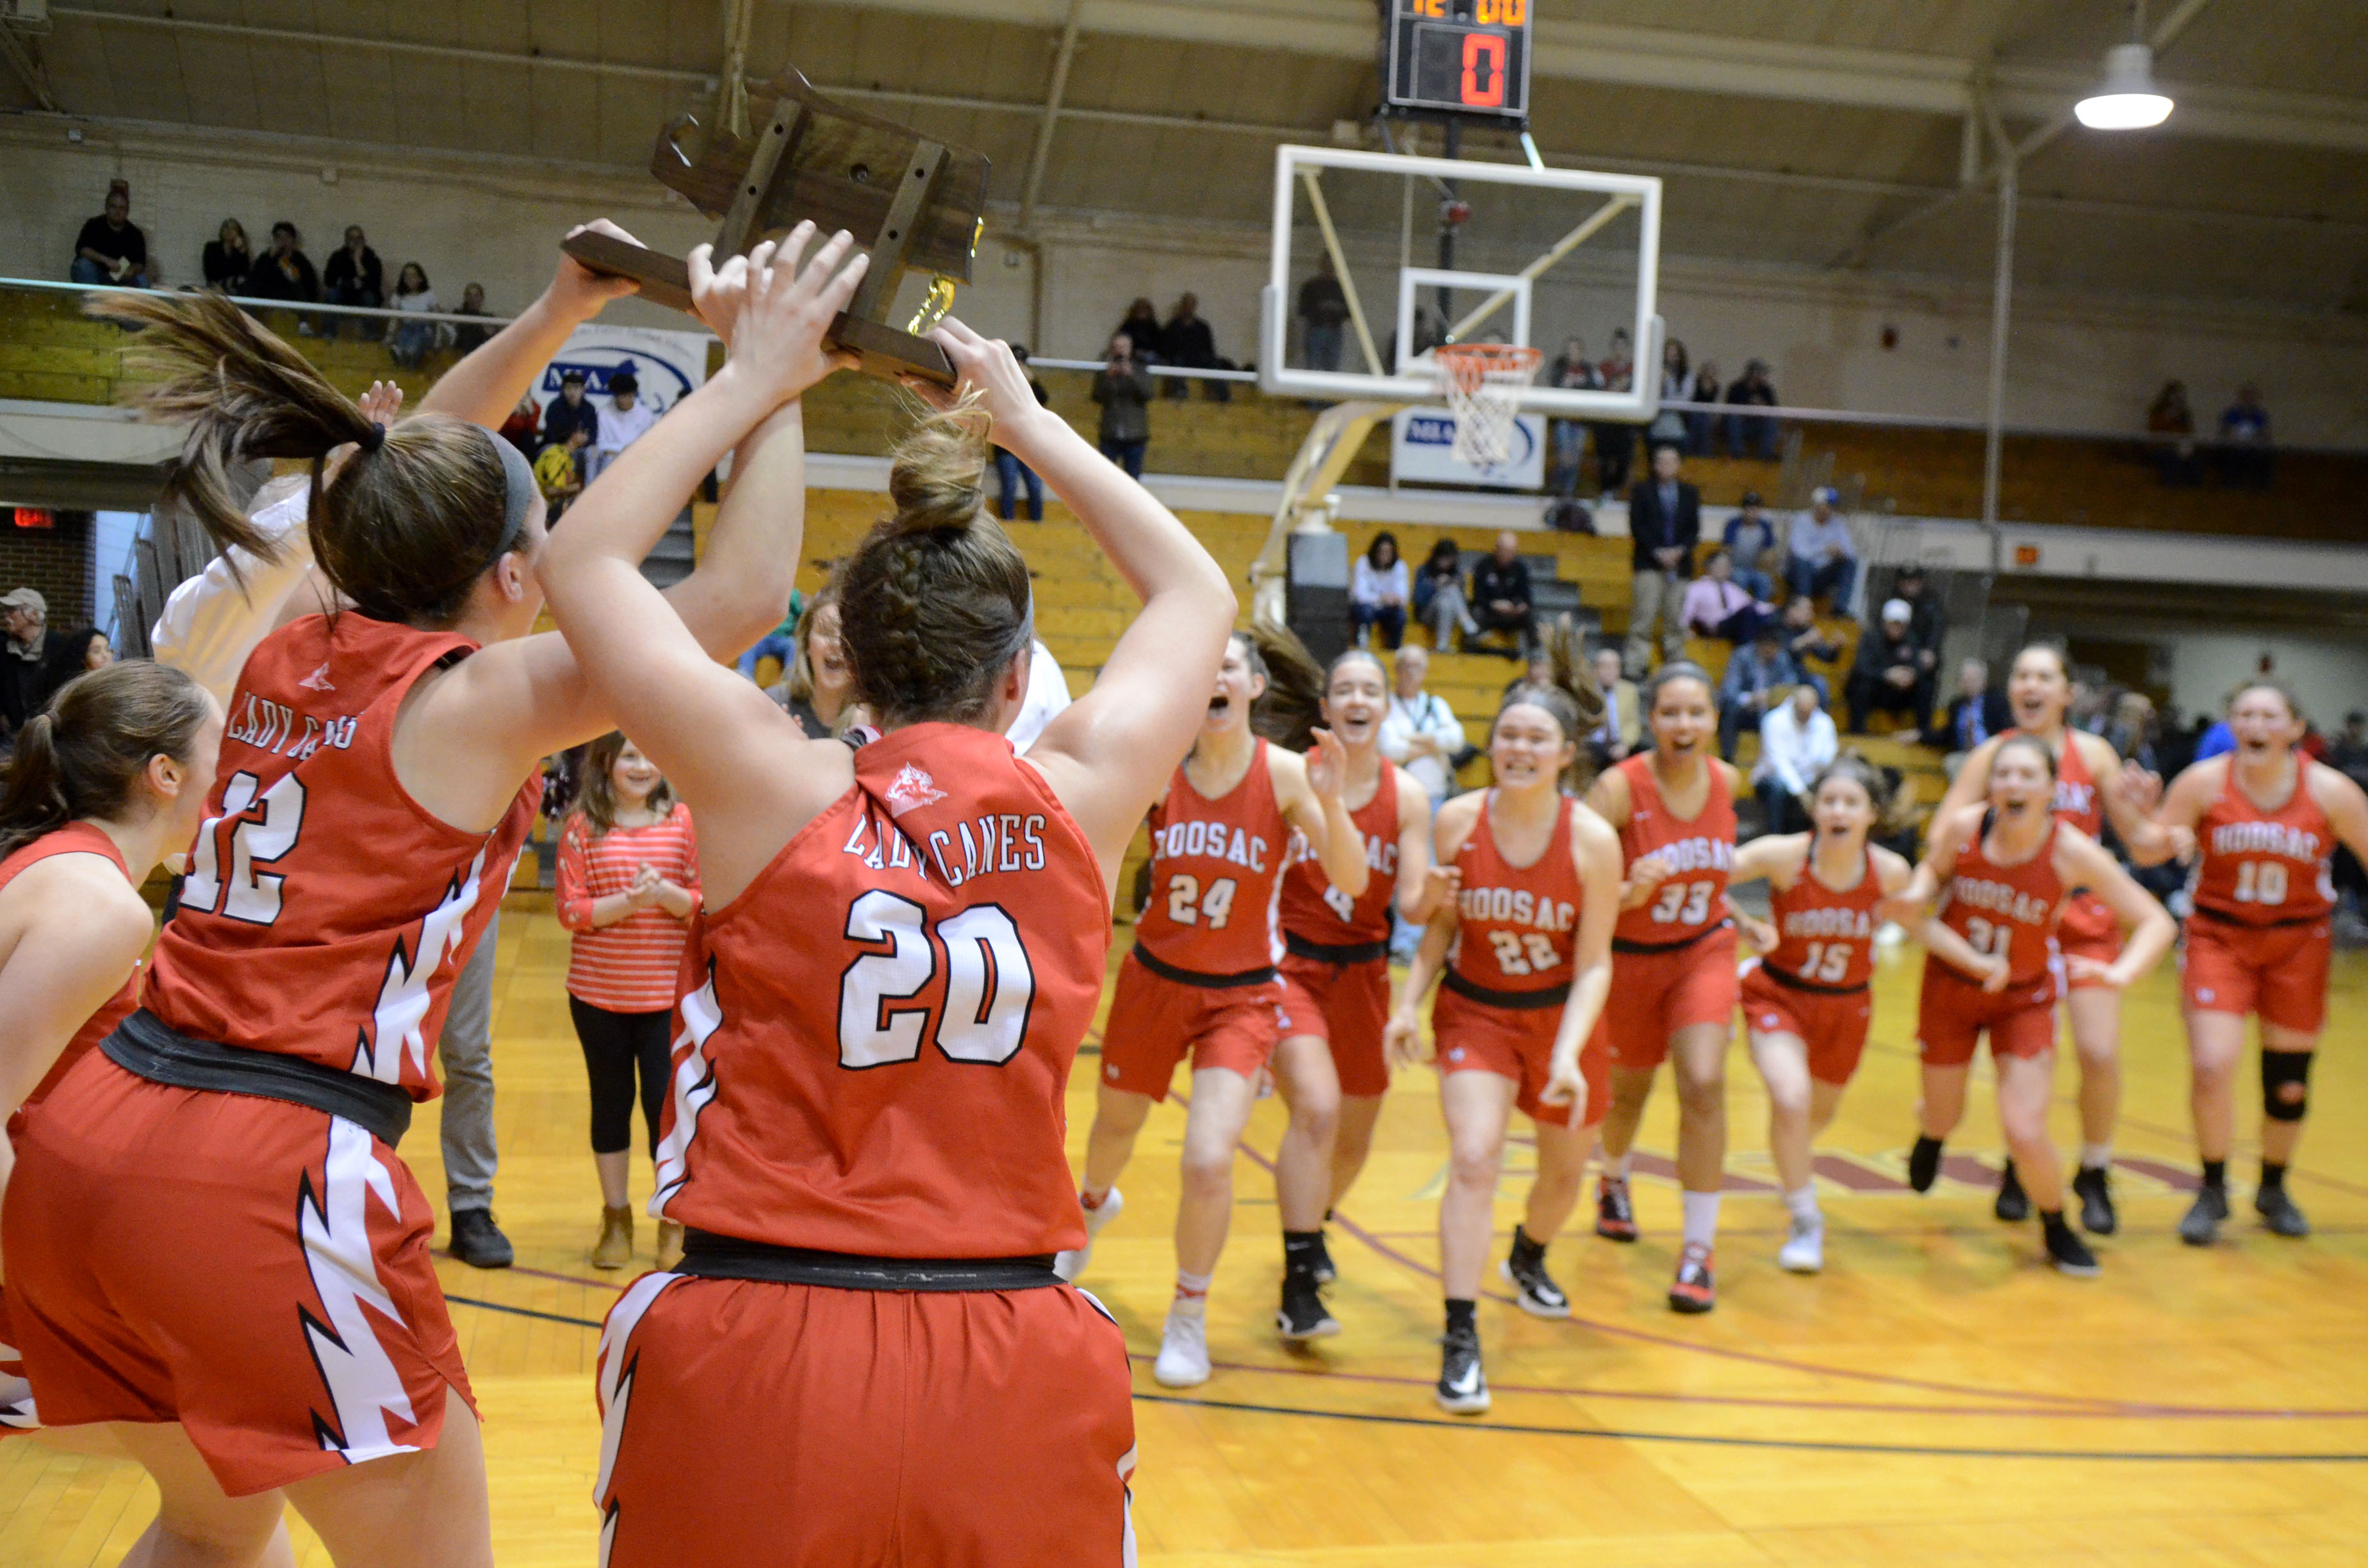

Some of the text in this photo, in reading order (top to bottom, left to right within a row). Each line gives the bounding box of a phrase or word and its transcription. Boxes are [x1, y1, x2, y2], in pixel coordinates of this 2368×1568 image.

[1461, 33, 1505, 106] 0
[227, 691, 293, 754] LADY
[179, 769, 307, 927] 12
[843, 813, 1046, 887] LADY CANES
[1644, 837, 1736, 876] OOSA
[1169, 874, 1237, 929] 24
[1652, 879, 1716, 925] 33
[2233, 861, 2289, 905] 10
[837, 888, 1036, 1071] 20
[1488, 929, 1562, 976] 22
[1798, 941, 1854, 983] 15
